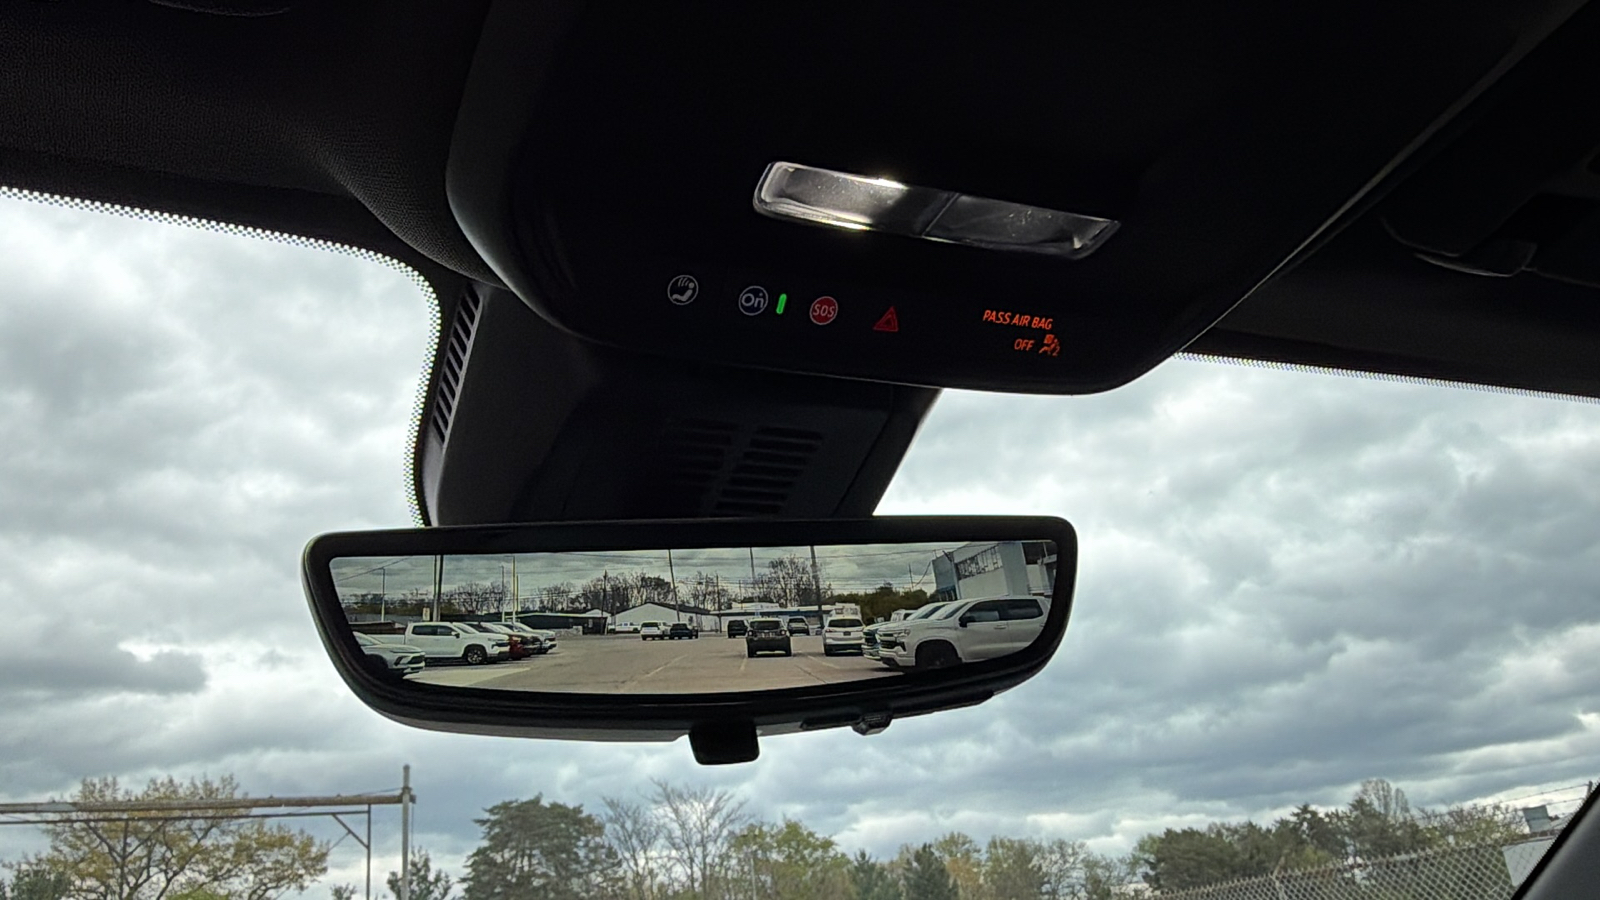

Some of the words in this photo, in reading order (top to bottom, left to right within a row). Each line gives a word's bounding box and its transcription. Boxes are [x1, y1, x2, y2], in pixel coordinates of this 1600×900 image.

[812, 303, 835, 318] SOS
[982, 309, 1012, 325] PASS
[1010, 313, 1031, 327] AIR
[1031, 316, 1054, 331] BAG
[1013, 338, 1035, 351] OFF
